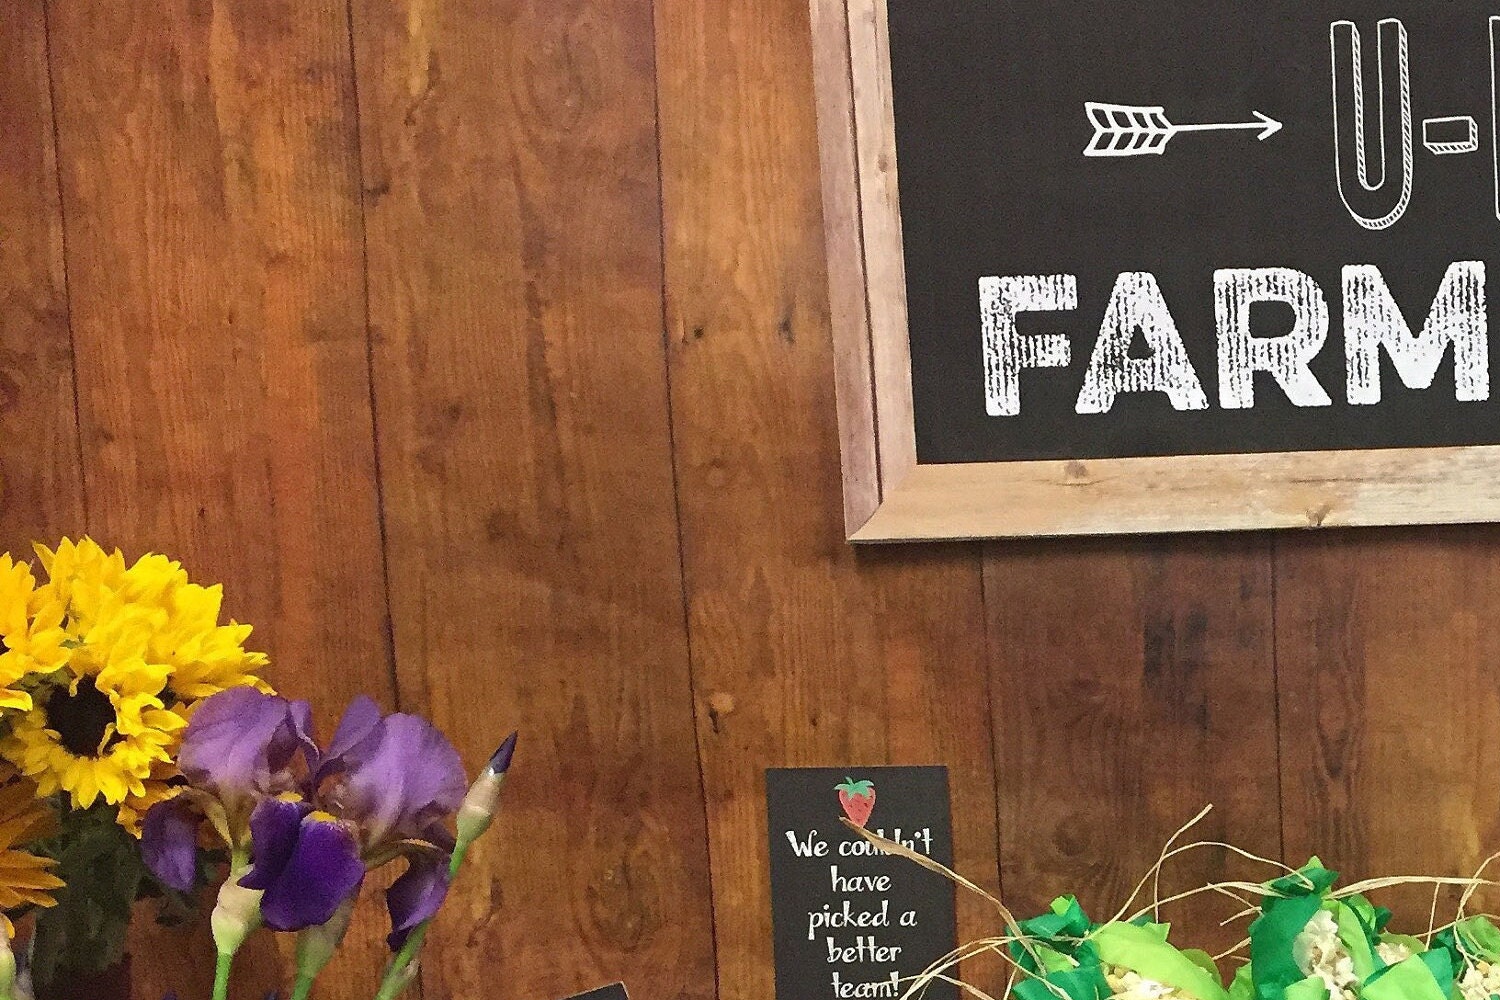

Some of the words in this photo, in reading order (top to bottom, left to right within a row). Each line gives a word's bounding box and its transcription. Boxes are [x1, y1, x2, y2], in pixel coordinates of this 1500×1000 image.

[979, 260, 1490, 416] FARM
[784, 829, 829, 857] We
[830, 865, 891, 891] have
[807, 899, 889, 941] picked
[899, 910, 917, 926] a
[826, 935, 901, 962] better
[831, 970, 900, 998] team!
